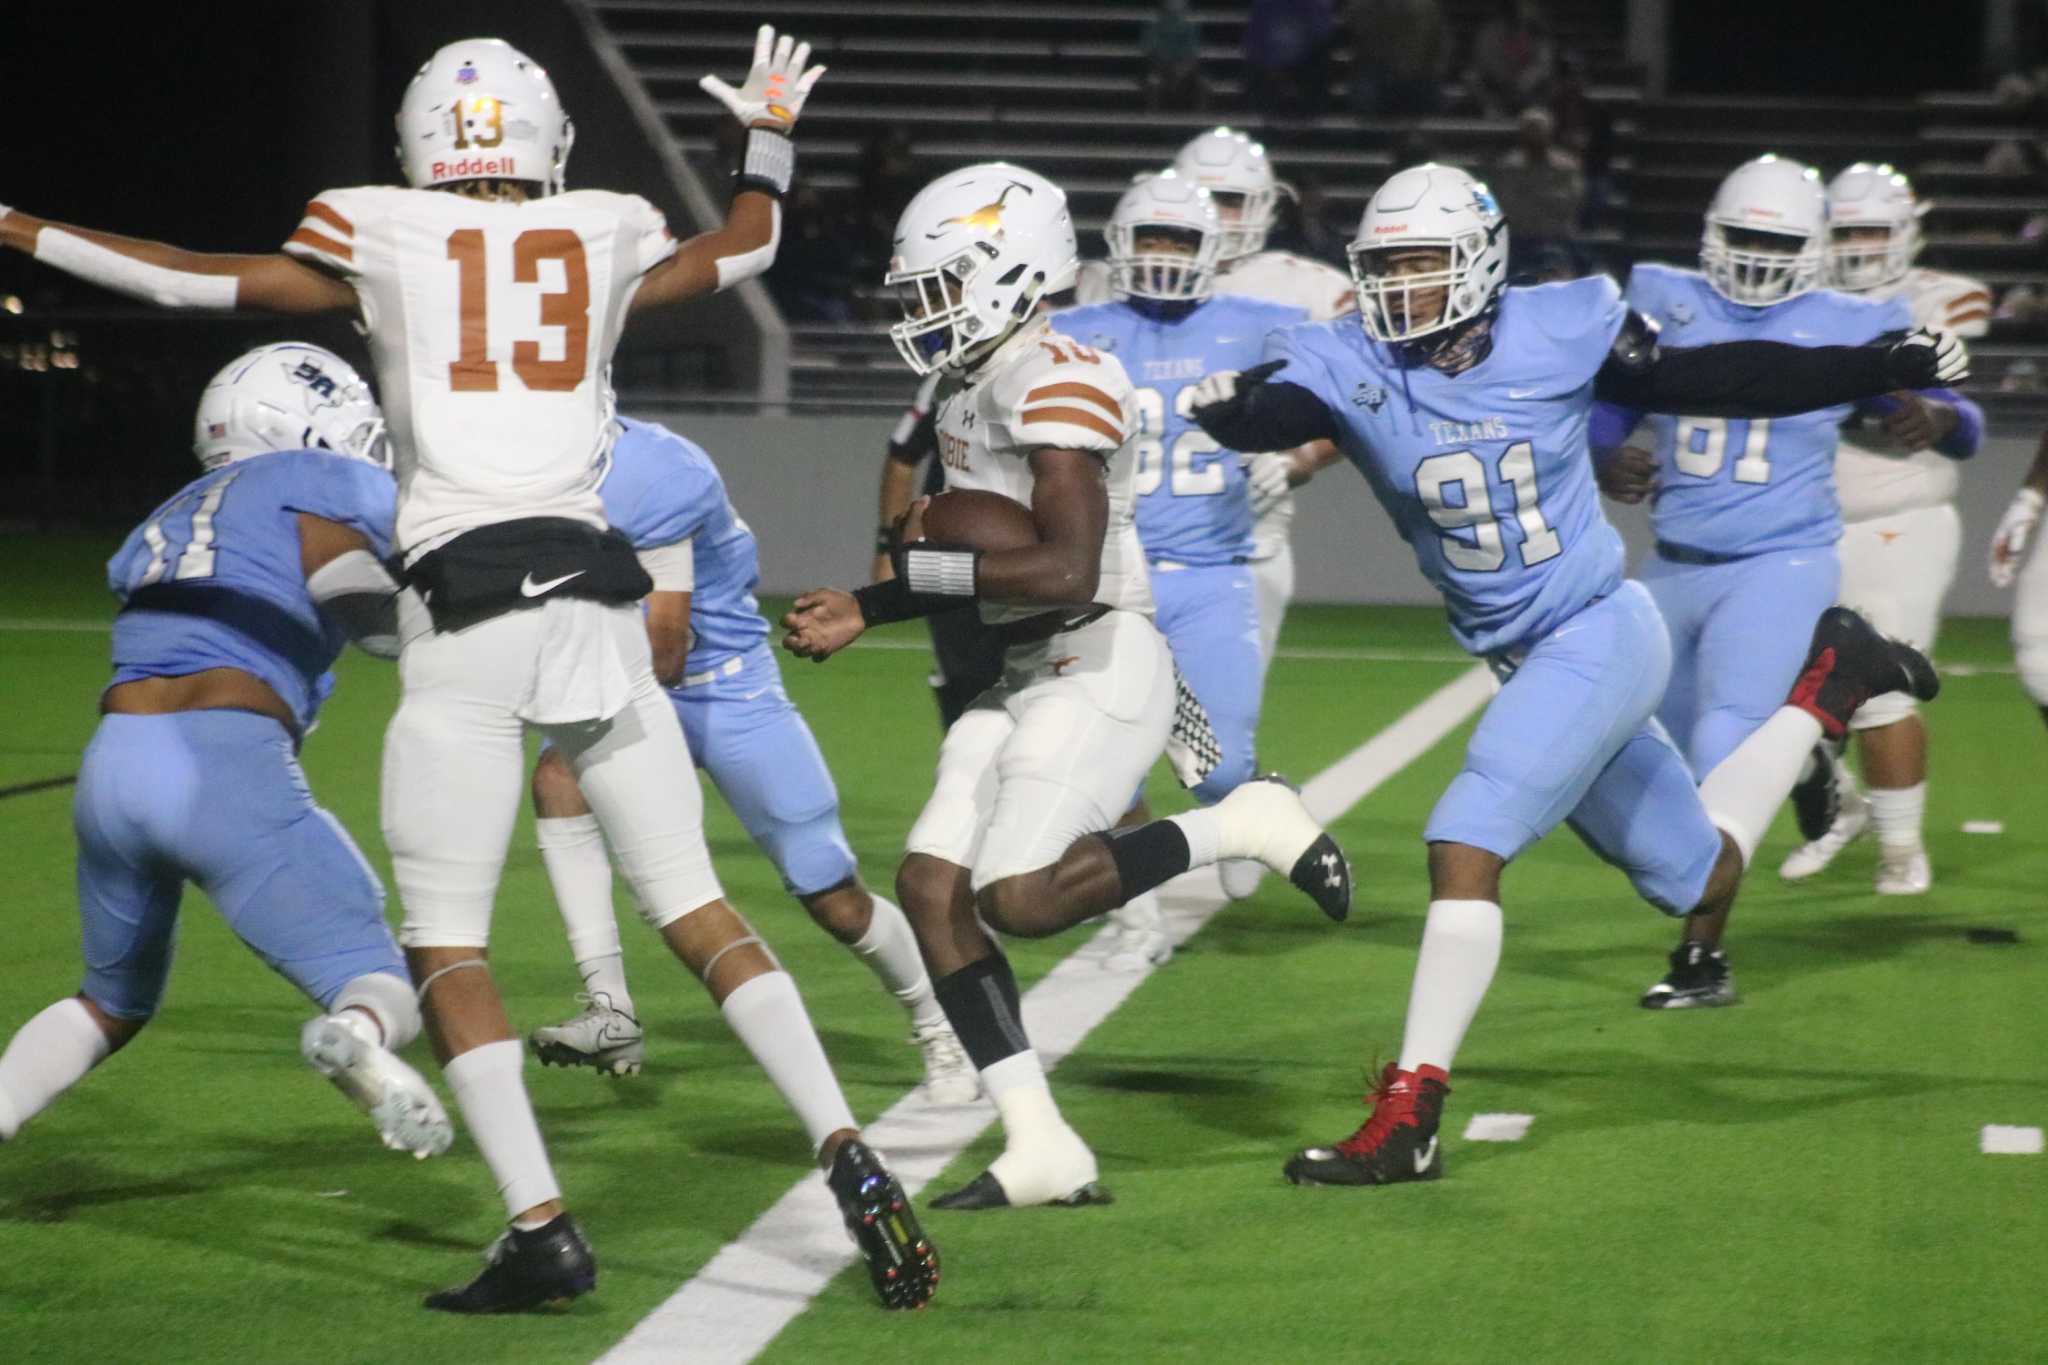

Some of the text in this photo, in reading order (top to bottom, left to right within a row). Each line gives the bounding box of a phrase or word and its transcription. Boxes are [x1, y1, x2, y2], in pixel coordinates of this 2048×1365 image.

[451, 97, 503, 150] 13
[432, 157, 515, 179] Riddell
[446, 228, 590, 393] 13
[1429, 416, 1509, 446] TEXANS
[1413, 440, 1562, 573] 91
